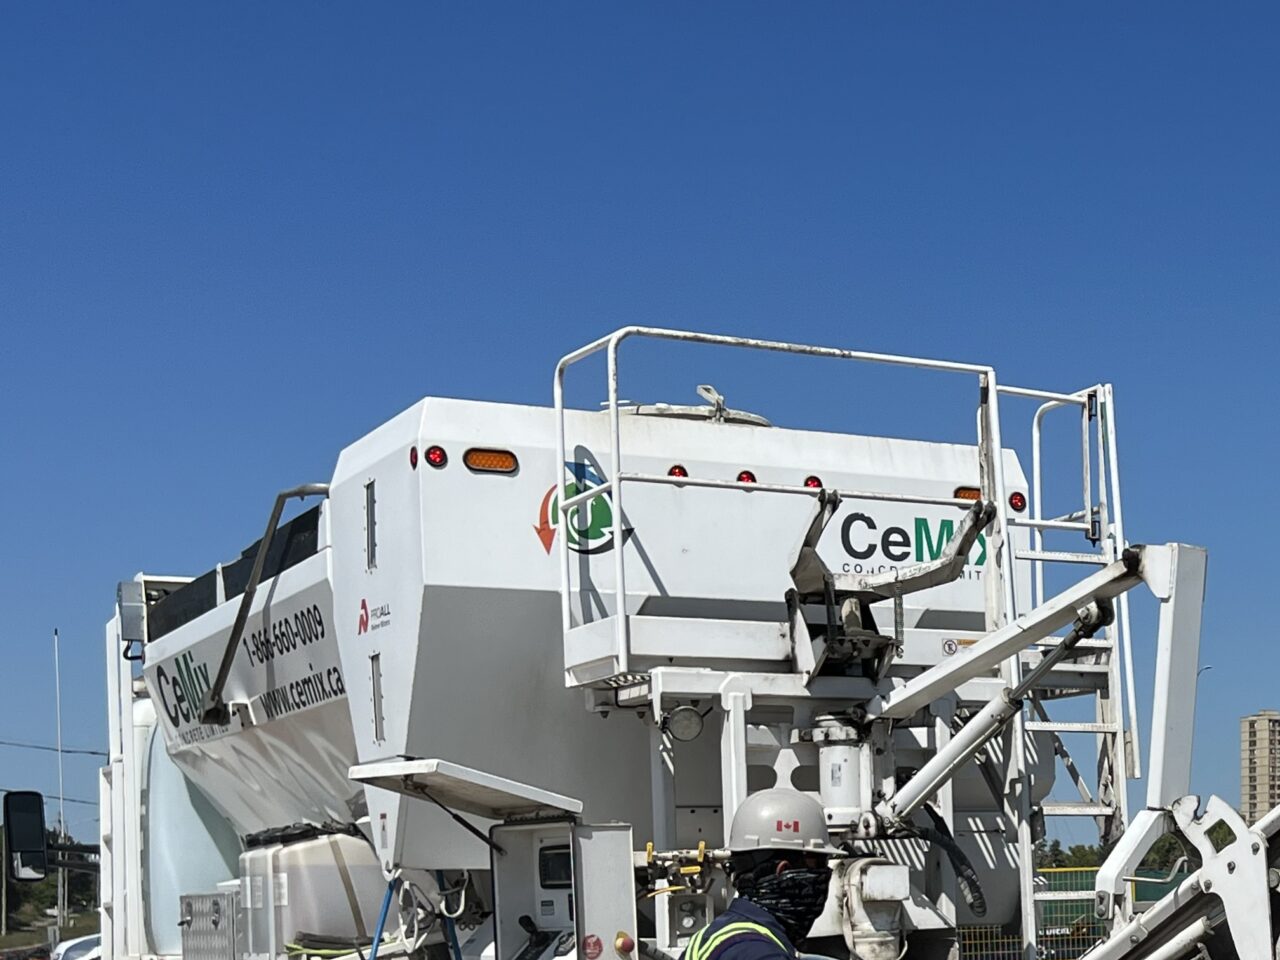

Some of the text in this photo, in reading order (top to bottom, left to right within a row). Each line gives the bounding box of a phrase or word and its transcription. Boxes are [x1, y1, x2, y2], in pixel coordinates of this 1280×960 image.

[841, 512, 987, 566] CeM
[243, 604, 325, 667] 1-866-660-0009
[259, 663, 346, 719] www.cemix.ca
